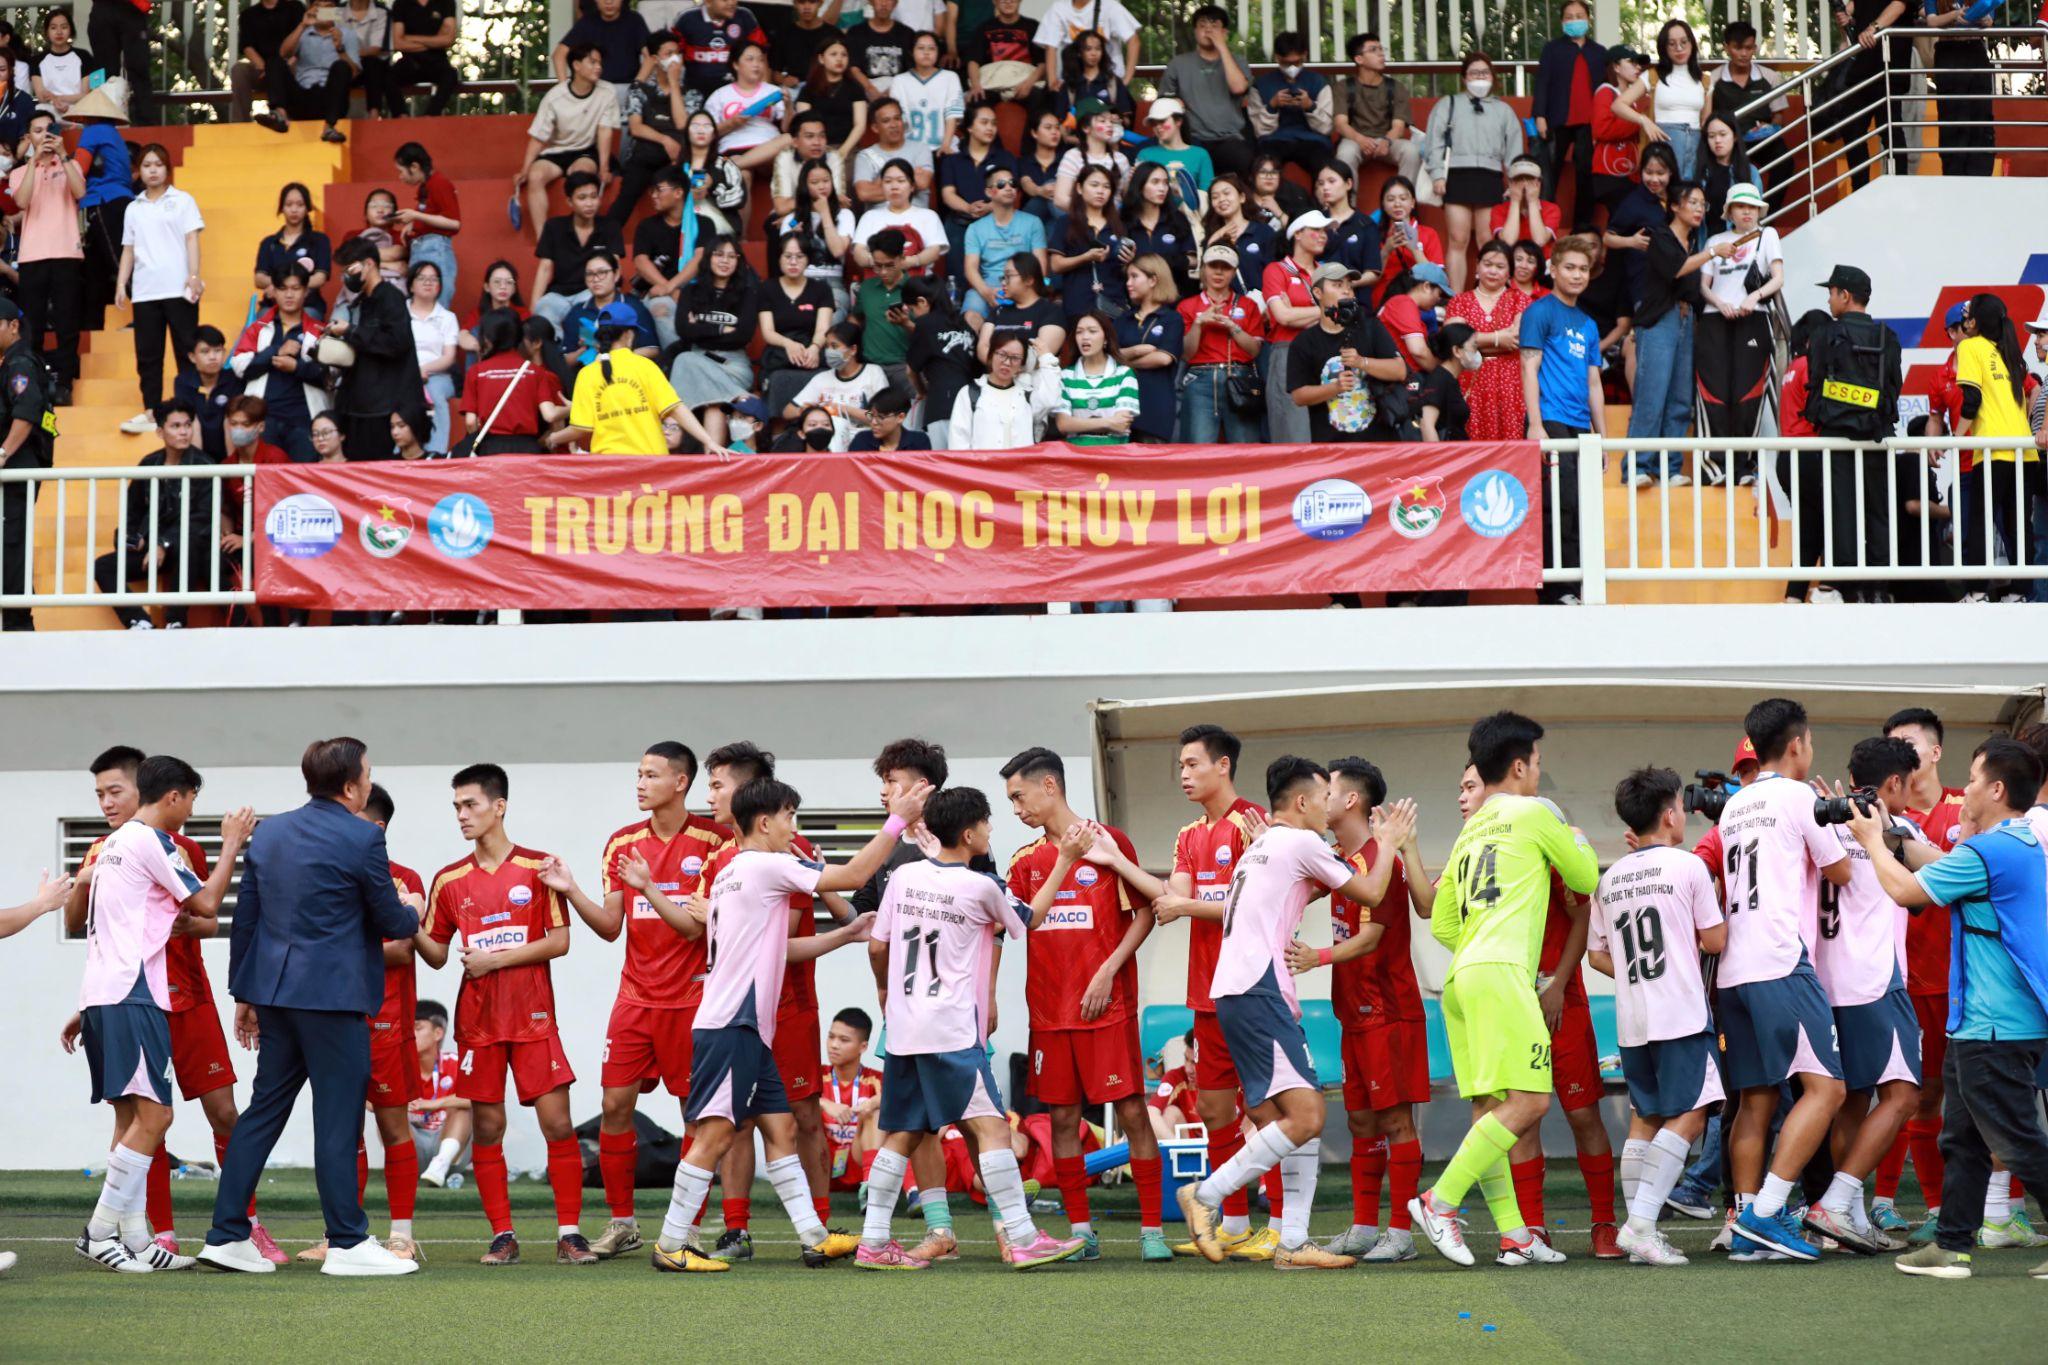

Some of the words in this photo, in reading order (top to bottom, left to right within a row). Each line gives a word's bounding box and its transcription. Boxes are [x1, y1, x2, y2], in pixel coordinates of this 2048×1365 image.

[1828, 383, 1873, 403] CSCĐ
[523, 483, 744, 556] TRƯỜNG
[764, 491, 860, 565] ĐẠI
[883, 489, 995, 563] HỌC
[1014, 472, 1156, 548] THỦY
[1176, 482, 1262, 556] LỢI
[1726, 837, 1760, 915] 21
[1819, 876, 1841, 941] 9
[474, 932, 525, 949] THACO
[903, 925, 942, 997] 11
[1613, 905, 1666, 985] 19
[163, 1056, 174, 1084] 4
[459, 1049, 475, 1076] 4
[602, 1038, 613, 1063] 5
